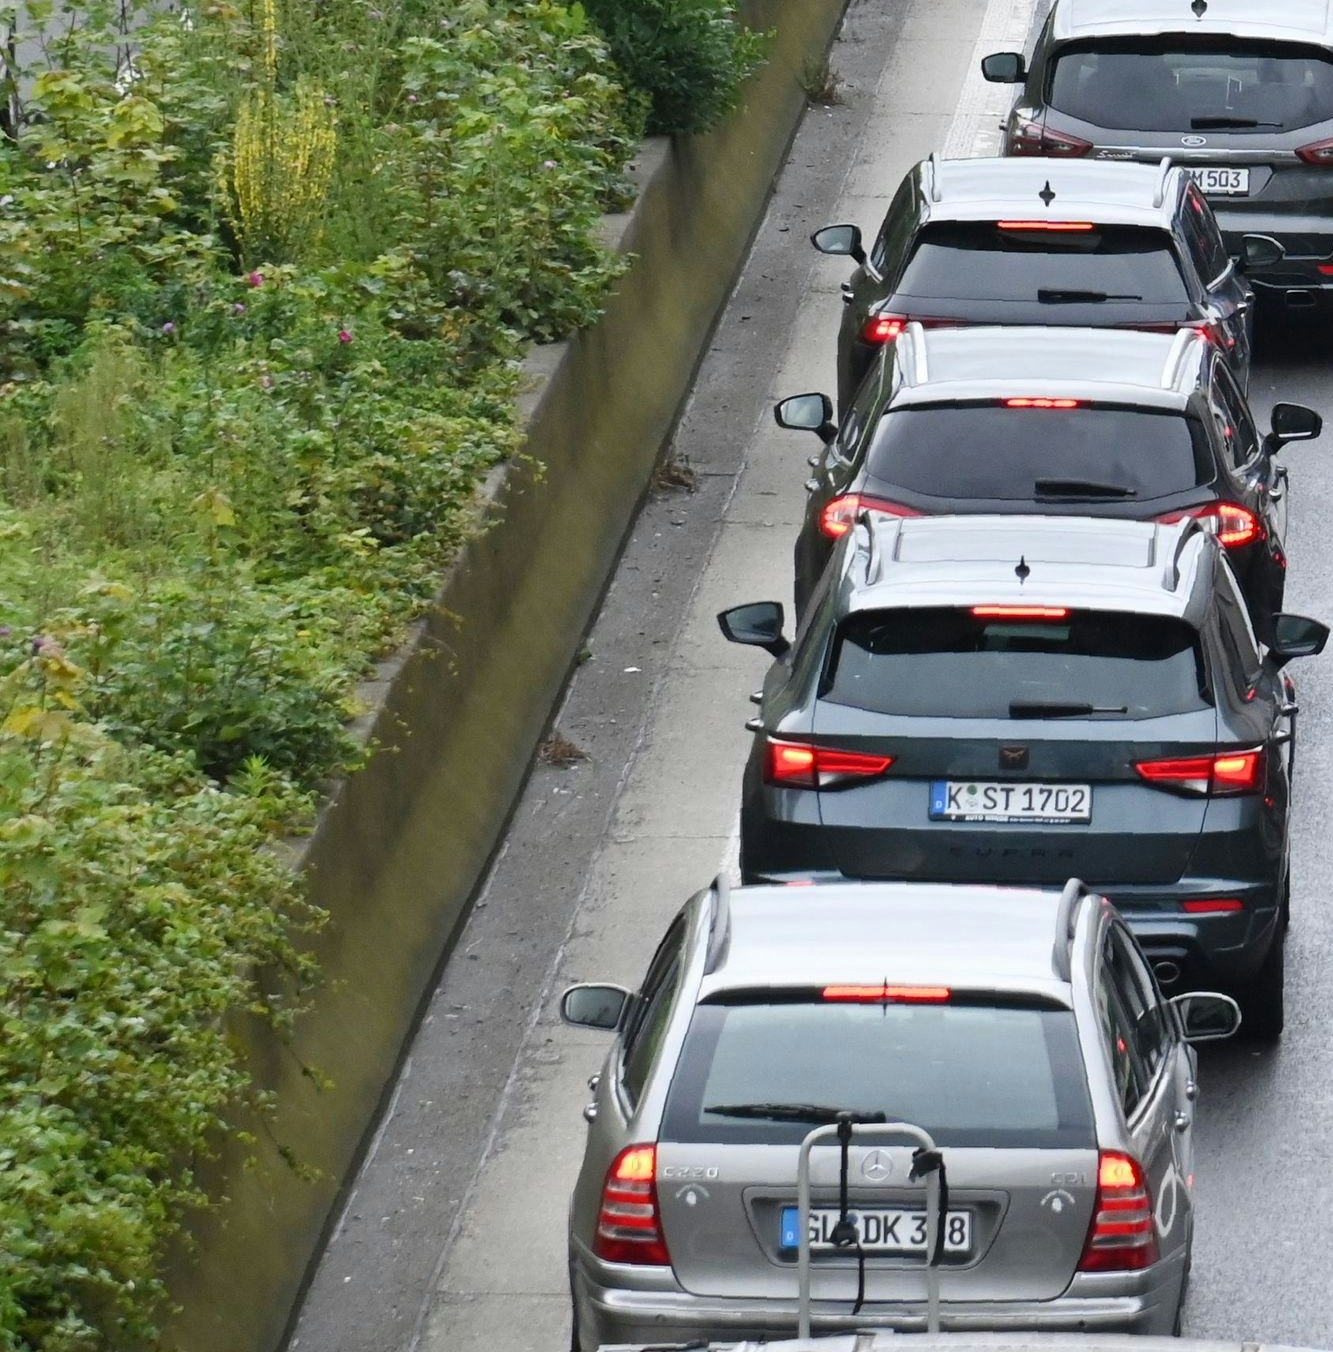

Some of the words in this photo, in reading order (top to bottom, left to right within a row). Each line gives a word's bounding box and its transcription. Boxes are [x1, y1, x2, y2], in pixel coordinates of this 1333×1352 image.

[1207, 171, 1241, 188] 503
[948, 786, 963, 810] K
[983, 786, 1015, 811] ST
[1021, 788, 1086, 813] 1702
[863, 1215, 902, 1245] DK
[910, 1215, 966, 1245] 38
